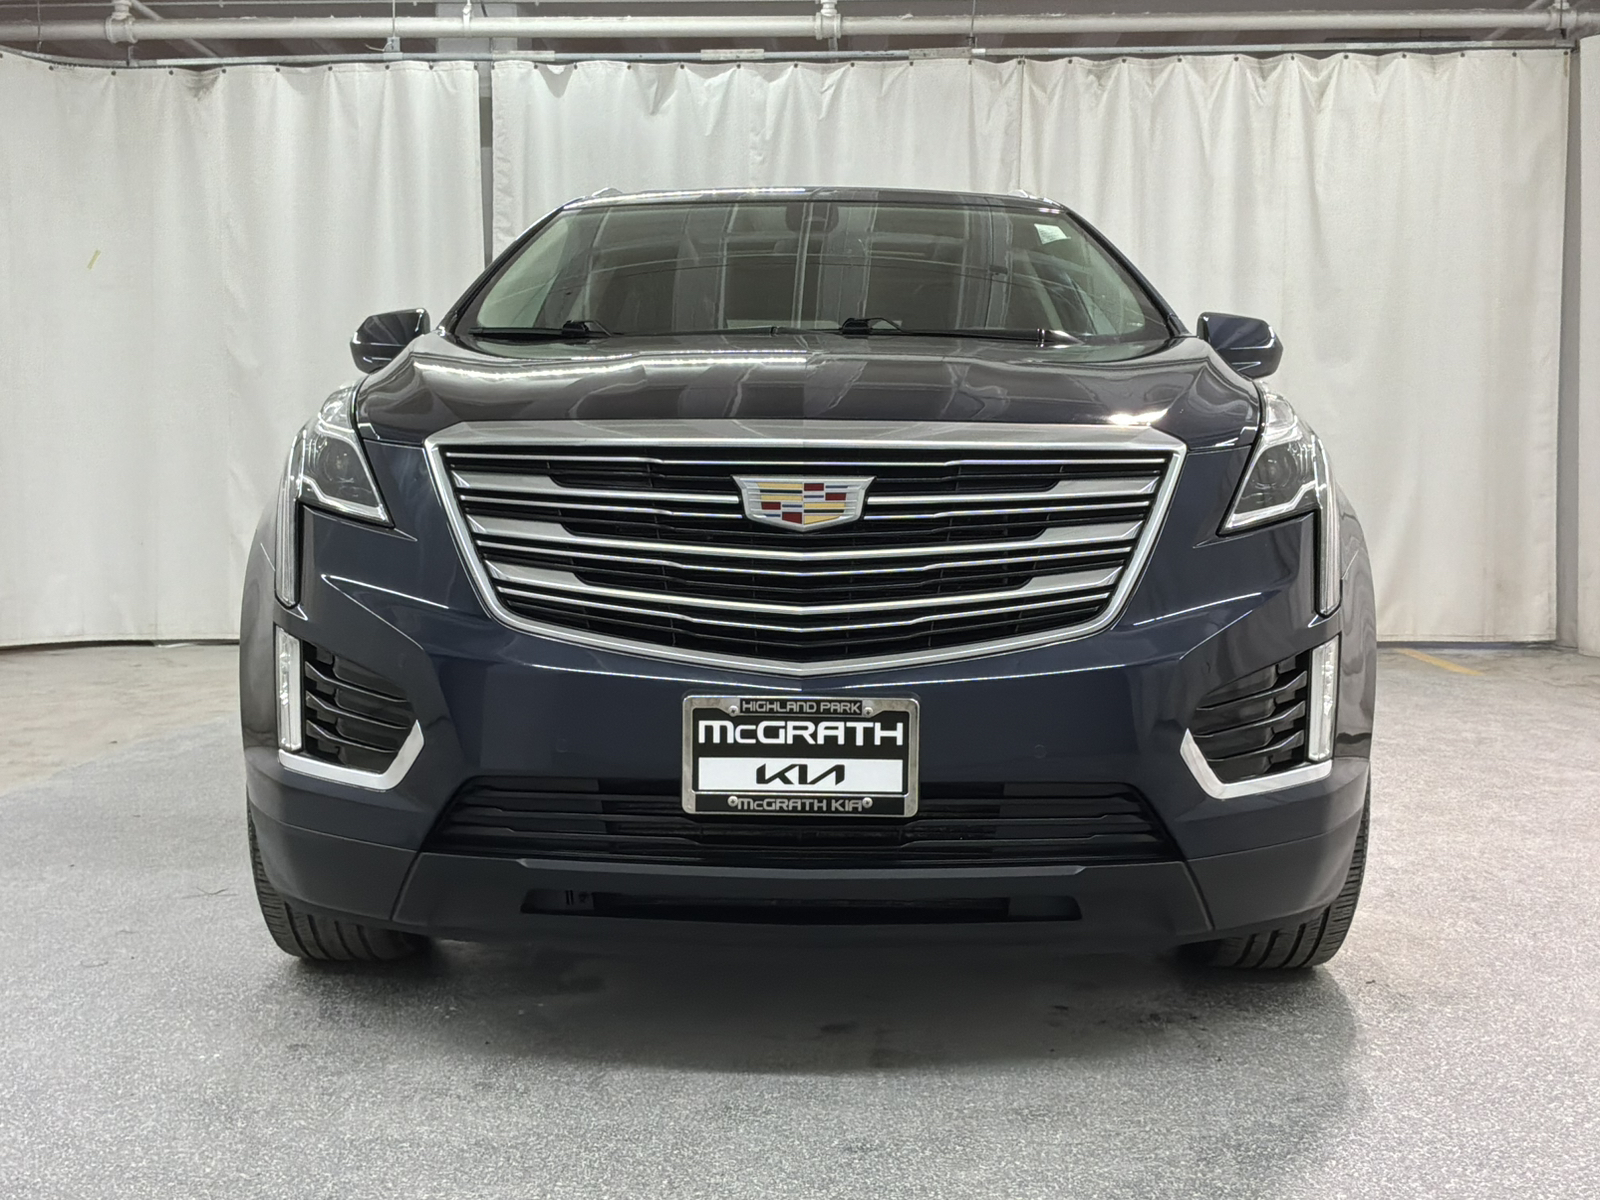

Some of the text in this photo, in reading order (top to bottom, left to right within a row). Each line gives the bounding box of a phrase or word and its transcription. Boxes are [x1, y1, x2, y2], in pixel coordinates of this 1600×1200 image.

[742, 701, 861, 713] HIGHLAND PARK
[698, 720, 904, 746] McGRATH
[737, 798, 863, 812] McGRATH KIA
